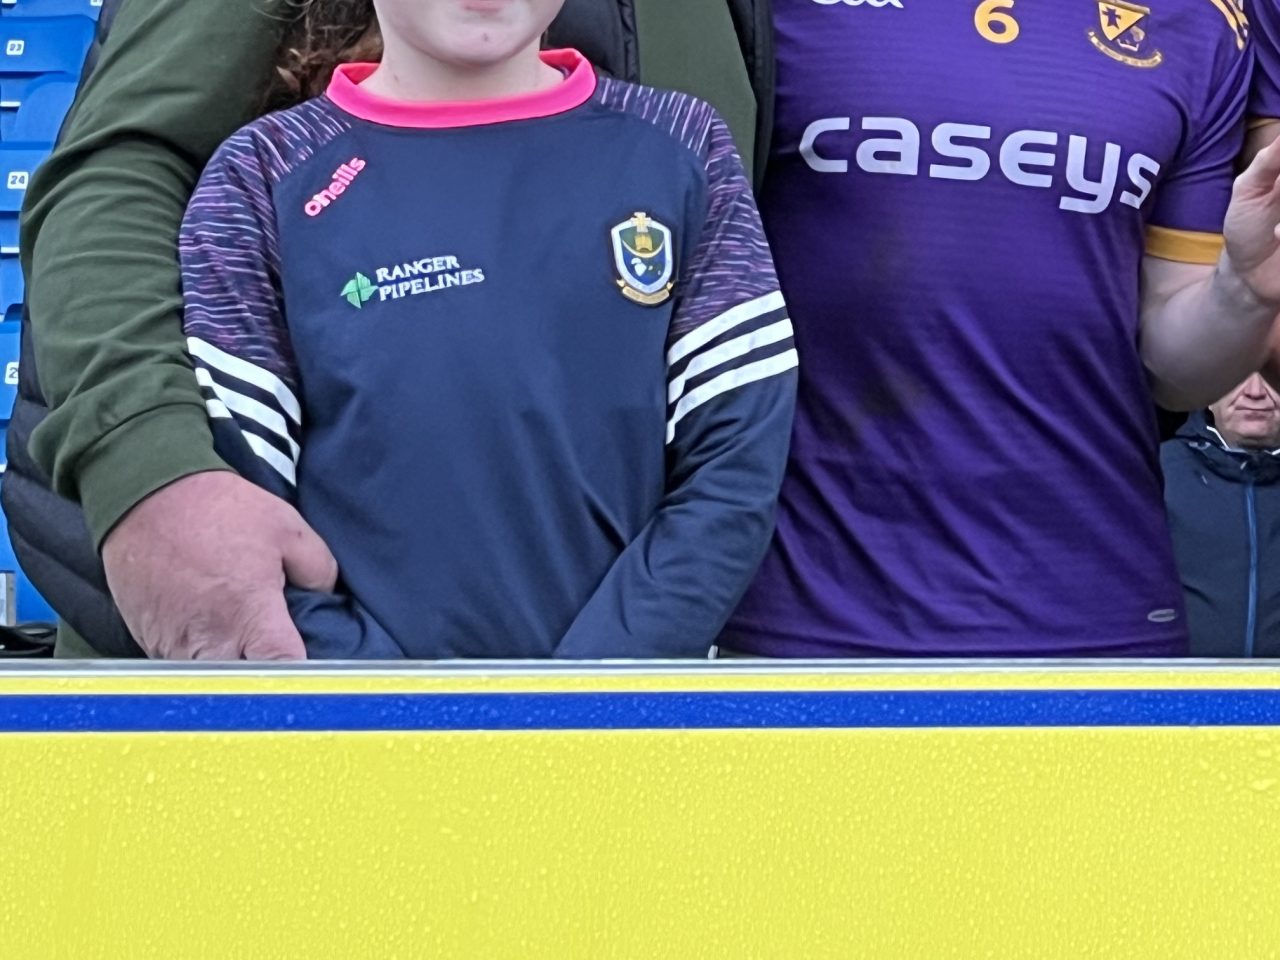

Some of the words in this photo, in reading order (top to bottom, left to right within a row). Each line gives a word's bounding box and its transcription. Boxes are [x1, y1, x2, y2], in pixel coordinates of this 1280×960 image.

[799, 116, 1161, 214] caseys
[375, 255, 460, 282] RANGER
[378, 268, 485, 301] PIPELINES
